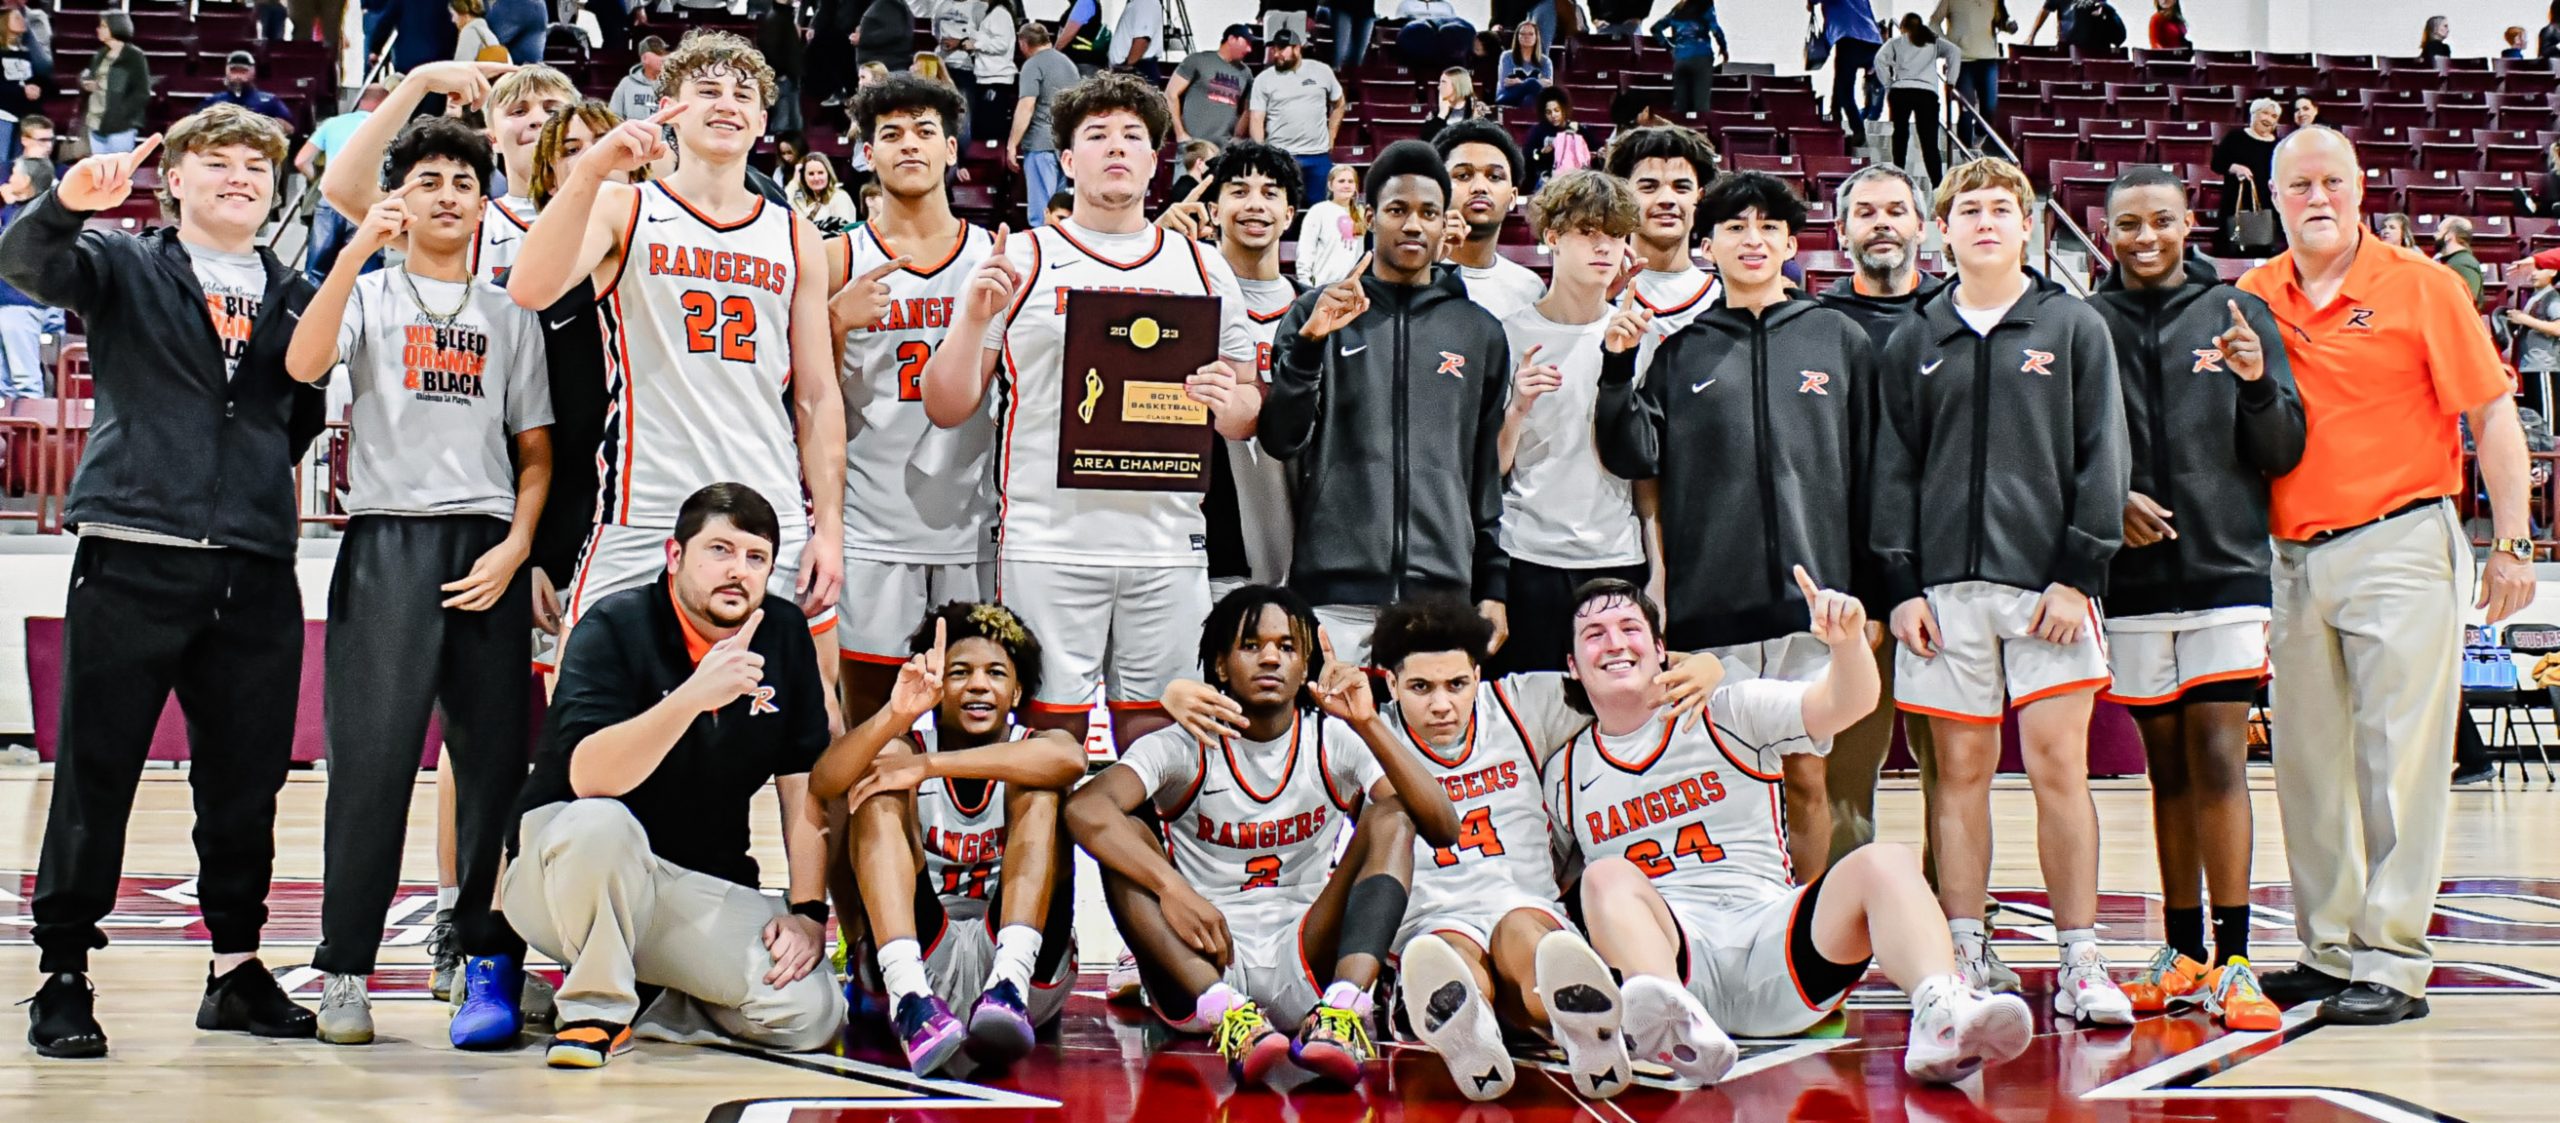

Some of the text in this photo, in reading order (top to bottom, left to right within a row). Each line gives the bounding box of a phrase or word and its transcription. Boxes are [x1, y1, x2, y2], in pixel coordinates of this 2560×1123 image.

[649, 243, 787, 295] RANGERS
[680, 289, 757, 364] 22
[867, 296, 955, 333] ANGE
[1110, 326, 1179, 338] 20 23
[403, 345, 487, 376] ORANGE
[404, 325, 488, 357] WE BLEED
[423, 371, 486, 398] BLACK
[896, 339, 945, 402] 2
[1131, 402, 1200, 412] BASKETBALL
[1072, 457, 1201, 473] AREA CHAMPION
[1436, 761, 1520, 803] GERS
[1196, 805, 1327, 849] RANGERS
[1586, 771, 1727, 845] RANGERS
[1624, 821, 1728, 880] 24
